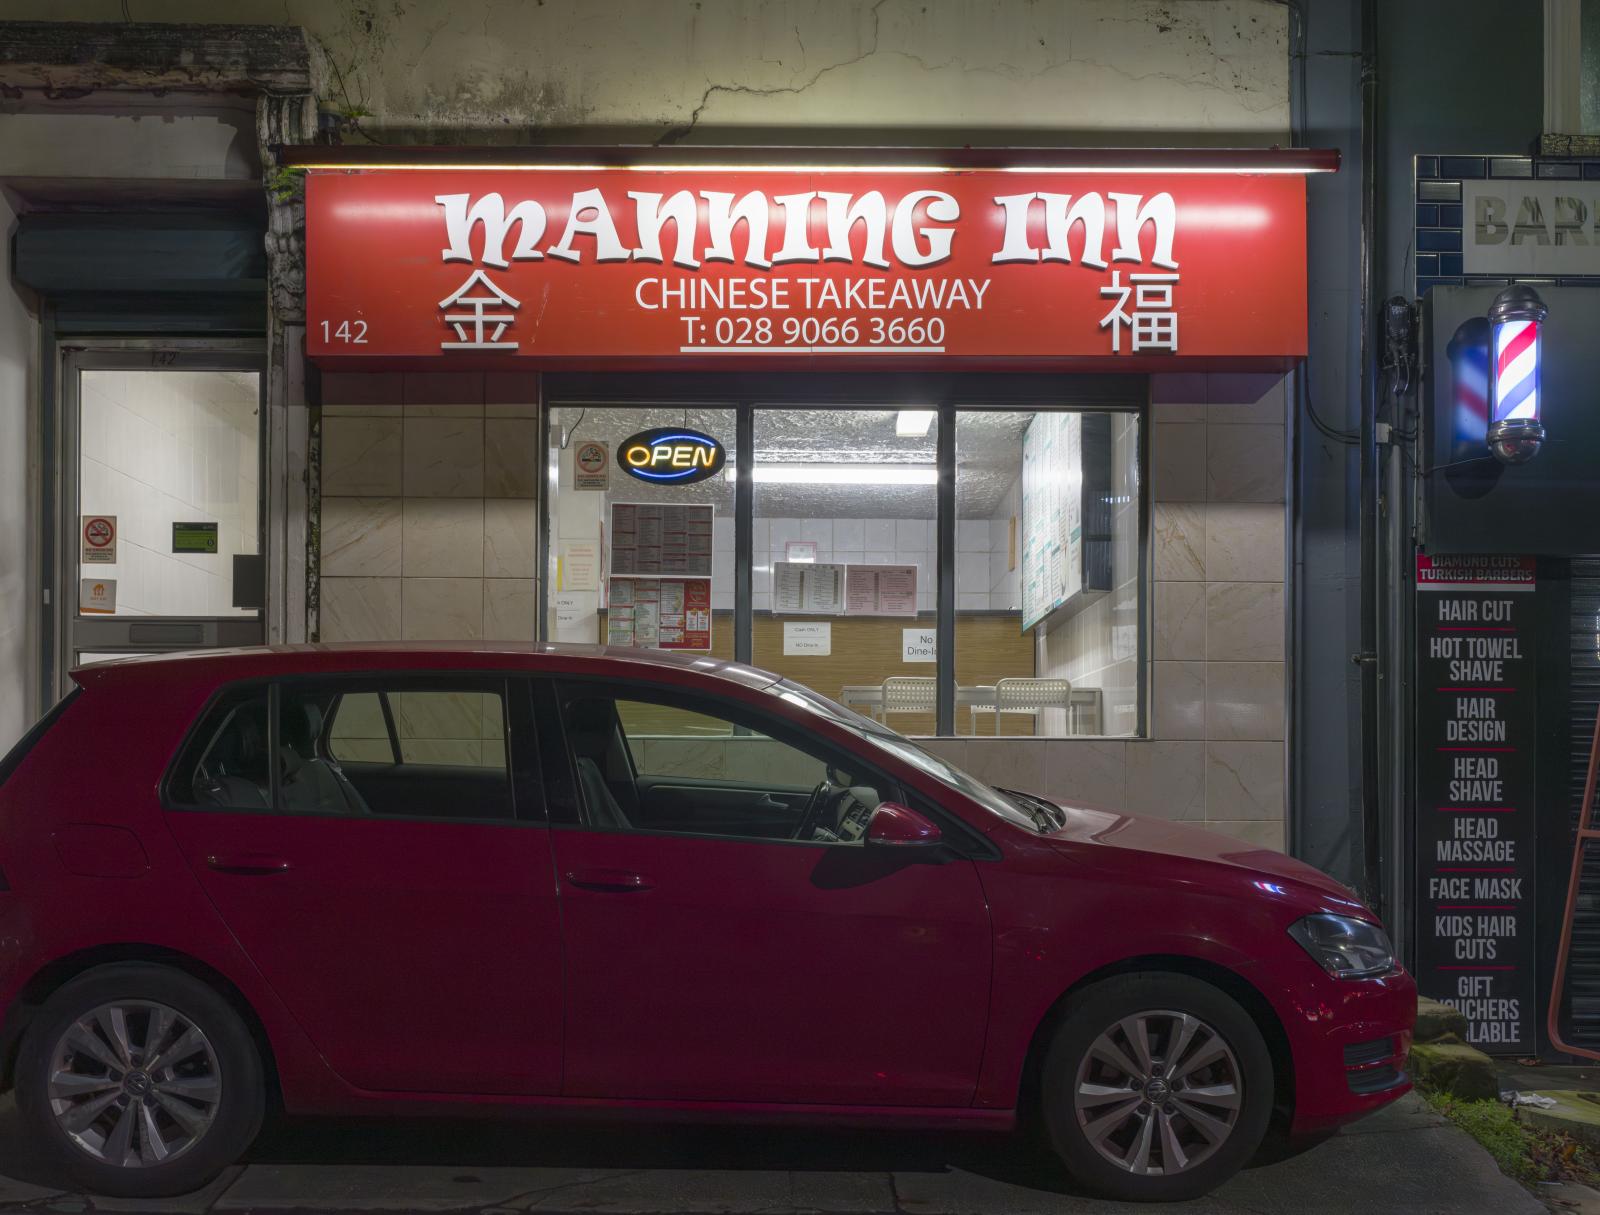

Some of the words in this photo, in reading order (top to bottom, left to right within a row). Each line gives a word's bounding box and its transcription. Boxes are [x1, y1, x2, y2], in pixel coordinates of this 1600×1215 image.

[435, 188, 960, 271] MANNING
[1474, 195, 1600, 246] BAR
[635, 278, 790, 310] CHINESE
[797, 278, 991, 310] TAKEAWAY
[438, 269, 521, 349] 金
[1100, 271, 1180, 352] 福
[320, 320, 368, 344] 142
[680, 317, 706, 344] T:
[716, 317, 773, 344] 028
[783, 317, 860, 344] 9066
[869, 317, 945, 344] 3660
[627, 445, 717, 468] OPEN
[1420, 568, 1473, 581] TURKISH
[1439, 600, 1478, 621] HAIR
[1482, 600, 1514, 621] CUT
[920, 635, 933, 644] No
[1431, 637, 1463, 658] HOT
[1466, 637, 1522, 658] TOWEL
[1449, 660, 1503, 681] SHAVE
[1456, 697, 1495, 719] HAIR
[1446, 720, 1505, 741] DESIGN
[1454, 757, 1498, 779] HEAD
[1449, 780, 1503, 802] SHAVE
[1454, 817, 1498, 839] HEAD
[1436, 840, 1515, 862] MASSAGE
[1429, 878, 1471, 899] FACE
[1475, 878, 1522, 899] MASK
[1435, 915, 1473, 937] KIDS
[1477, 915, 1516, 937] HAIR
[1455, 938, 1497, 960] CUTS
[1457, 976, 1494, 997] GIFT
[1441, 998, 1520, 1020] UCHERS
[1466, 1021, 1521, 1043] LABLE
